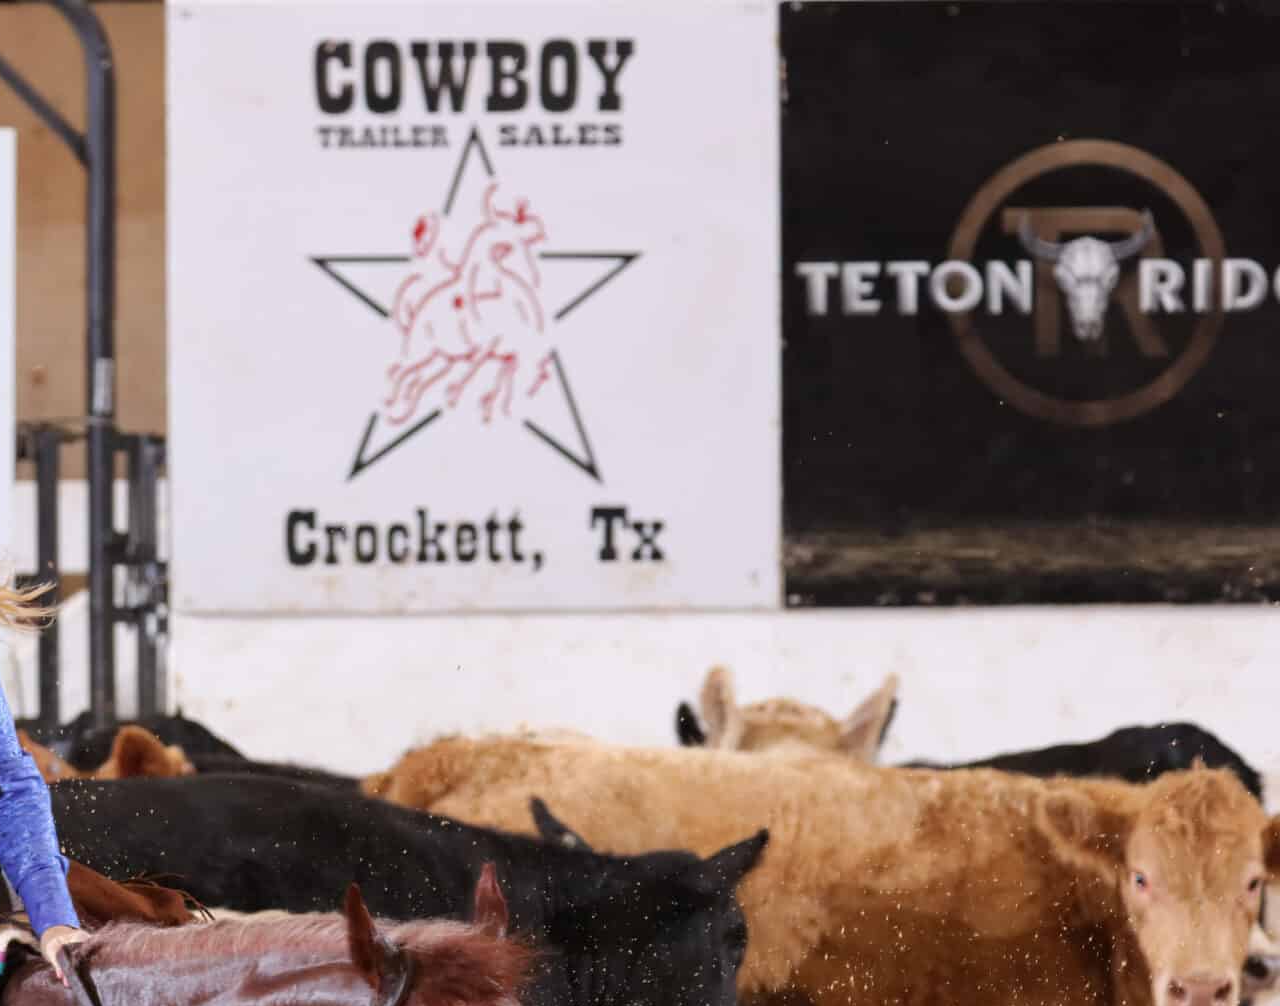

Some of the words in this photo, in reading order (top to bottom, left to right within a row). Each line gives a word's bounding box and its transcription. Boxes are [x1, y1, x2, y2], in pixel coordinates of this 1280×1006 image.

[314, 39, 635, 114] COWBOY
[317, 125, 450, 149] TRAILER
[499, 125, 624, 146] SALES
[794, 259, 1034, 316] TETON
[1138, 257, 1280, 313] RID
[286, 508, 545, 571] Crockett,
[591, 506, 665, 562] Tx
